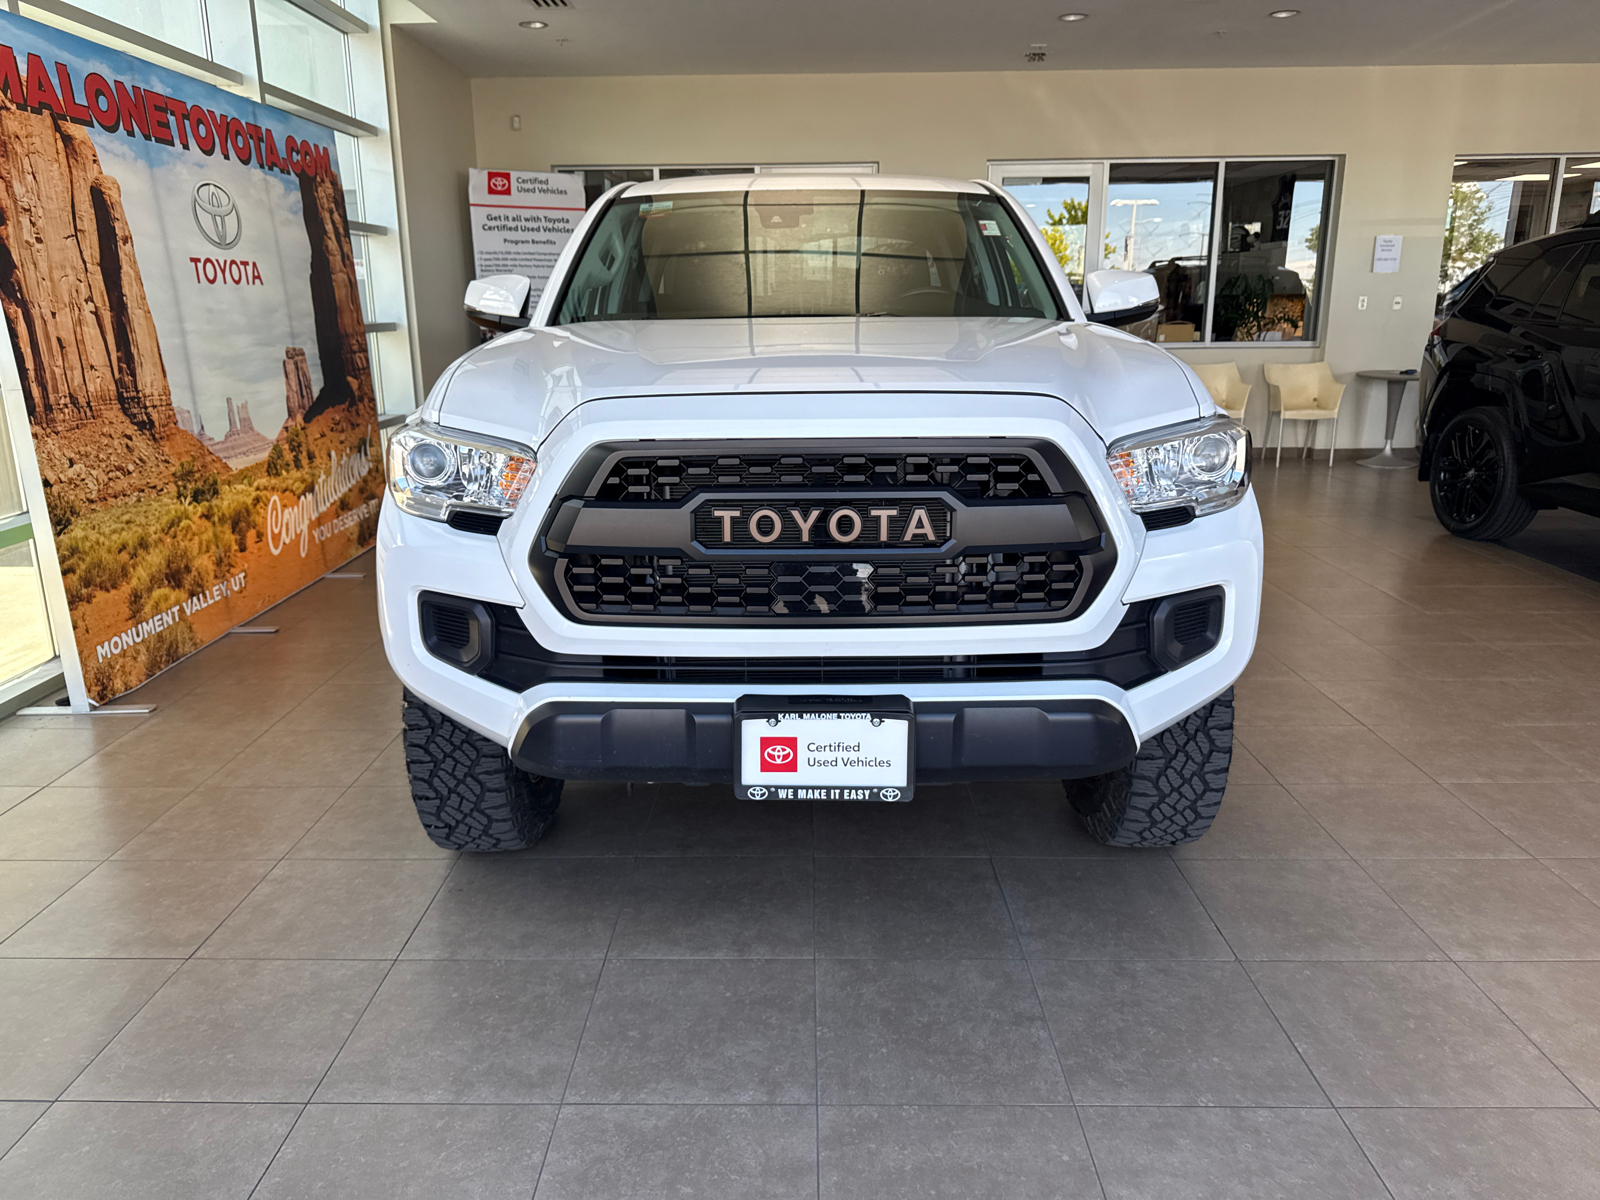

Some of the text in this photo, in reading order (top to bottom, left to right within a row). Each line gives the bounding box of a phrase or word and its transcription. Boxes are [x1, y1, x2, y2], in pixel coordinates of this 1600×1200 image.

[516, 177, 549, 185] Certified
[517, 186, 568, 196] Used Vehicles
[486, 214, 502, 222] Get
[504, 214, 509, 222] it
[511, 214, 522, 222] all
[543, 216, 570, 225] Toyota
[482, 224, 518, 232] Certified
[520, 224, 540, 233] Used
[503, 238, 530, 246] Program
[189, 256, 264, 286] TOYOTA
[312, 522, 332, 544] YOU
[332, 503, 370, 535] DESERVE
[712, 506, 936, 543] TOYOTA
[95, 572, 246, 663] MONUMENT VALLEY, UT
[806, 742, 860, 752] Certified
[807, 757, 892, 768] Used Vehicles
[778, 788, 870, 800] WE MAKE IT EASY
